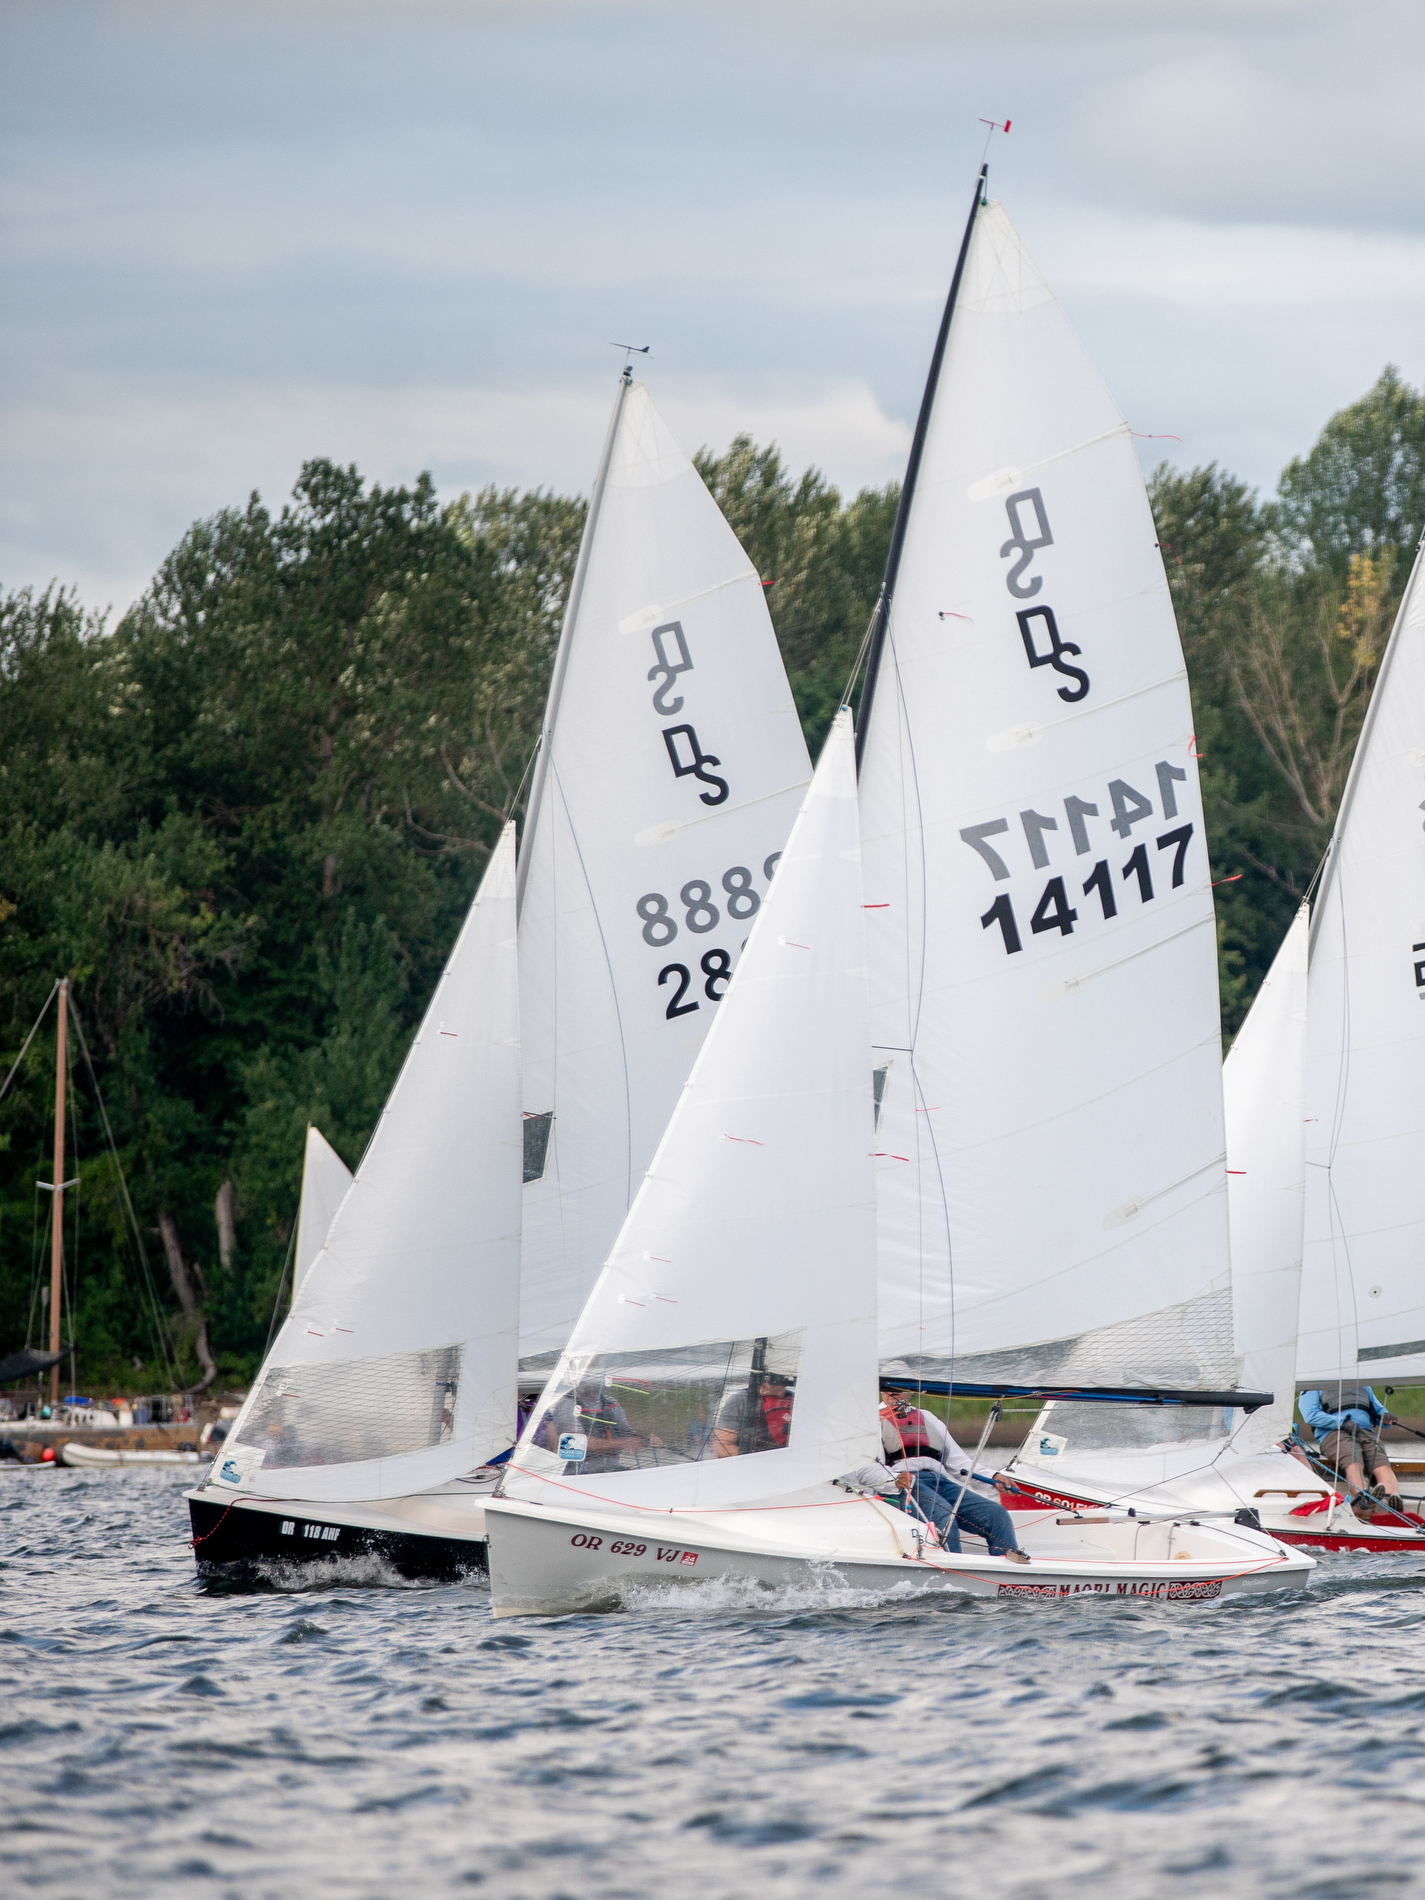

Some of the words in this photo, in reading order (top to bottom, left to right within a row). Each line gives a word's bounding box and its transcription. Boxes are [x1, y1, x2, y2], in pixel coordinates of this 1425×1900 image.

[1016, 604, 1090, 703] DS
[662, 724, 729, 806] DS
[980, 822, 1194, 955] 14117
[282, 1521, 295, 1535] OR
[304, 1524, 321, 1538] 118
[321, 1527, 341, 1541] AHF
[571, 1534, 603, 1550] OR
[610, 1541, 647, 1556] 629
[656, 1548, 681, 1562] VJ
